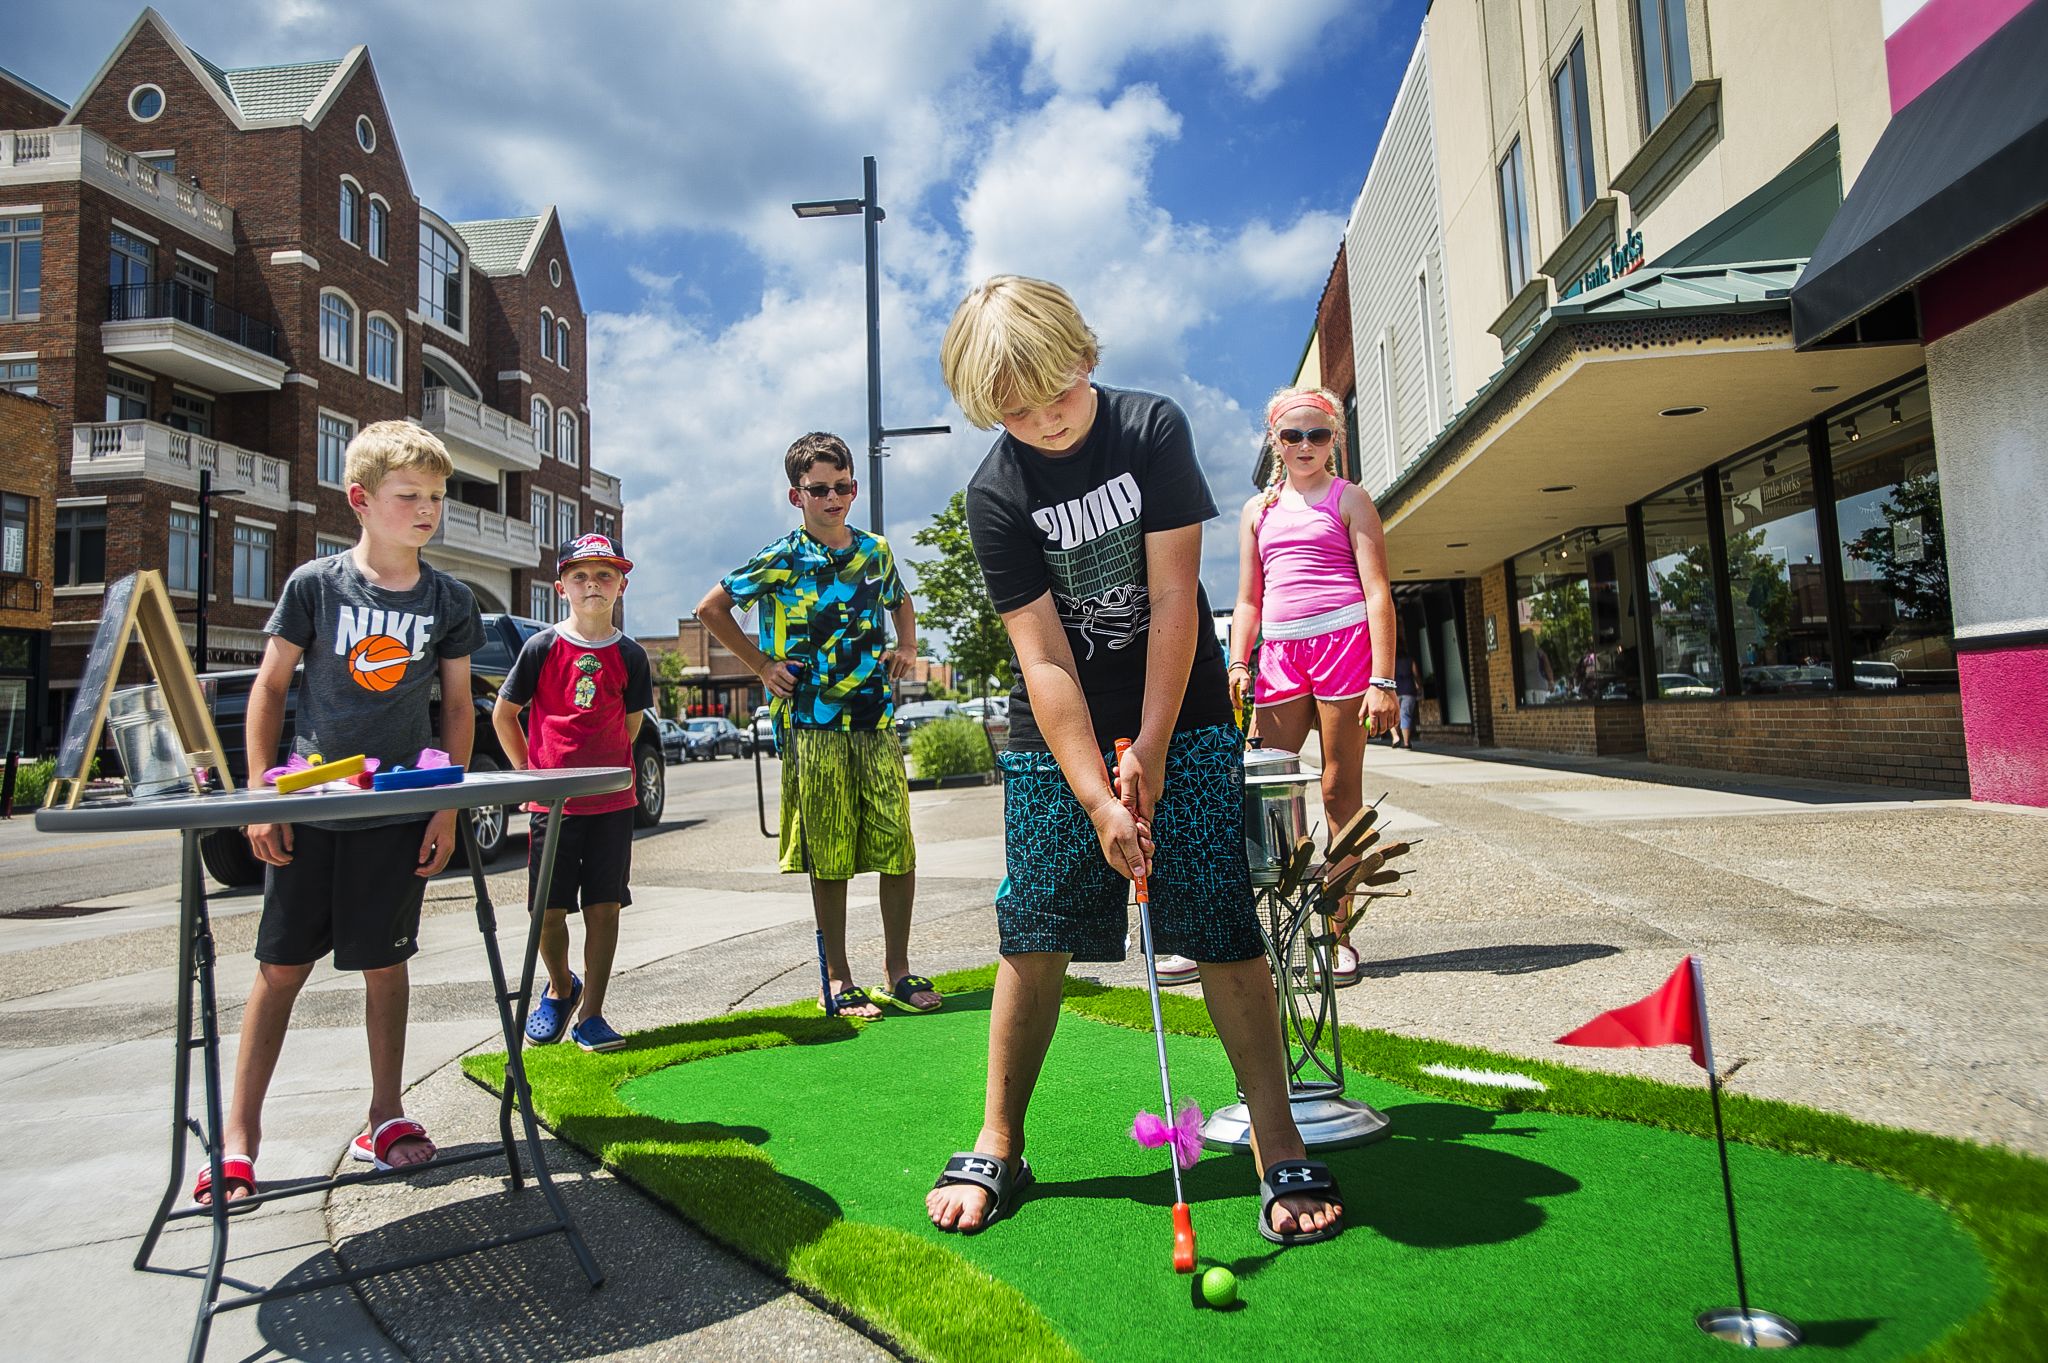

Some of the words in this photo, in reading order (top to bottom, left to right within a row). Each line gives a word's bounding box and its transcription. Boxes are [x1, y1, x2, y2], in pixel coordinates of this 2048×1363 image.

[1611, 228, 1643, 280] forks
[1763, 481, 1780, 502] little
[1781, 474, 1801, 495] forks
[1031, 472, 1142, 550] PUMA
[1068, 544, 1093, 563] PUMA
[1095, 533, 1120, 553] PUMA
[1070, 556, 1097, 574] PUMA
[1097, 544, 1124, 564] PUMA
[1071, 567, 1099, 586] PUMA
[1100, 556, 1130, 576] PUMA
[1073, 578, 1102, 597] PUMA
[1103, 565, 1133, 587] PUMA
[335, 605, 434, 661] NIKE
